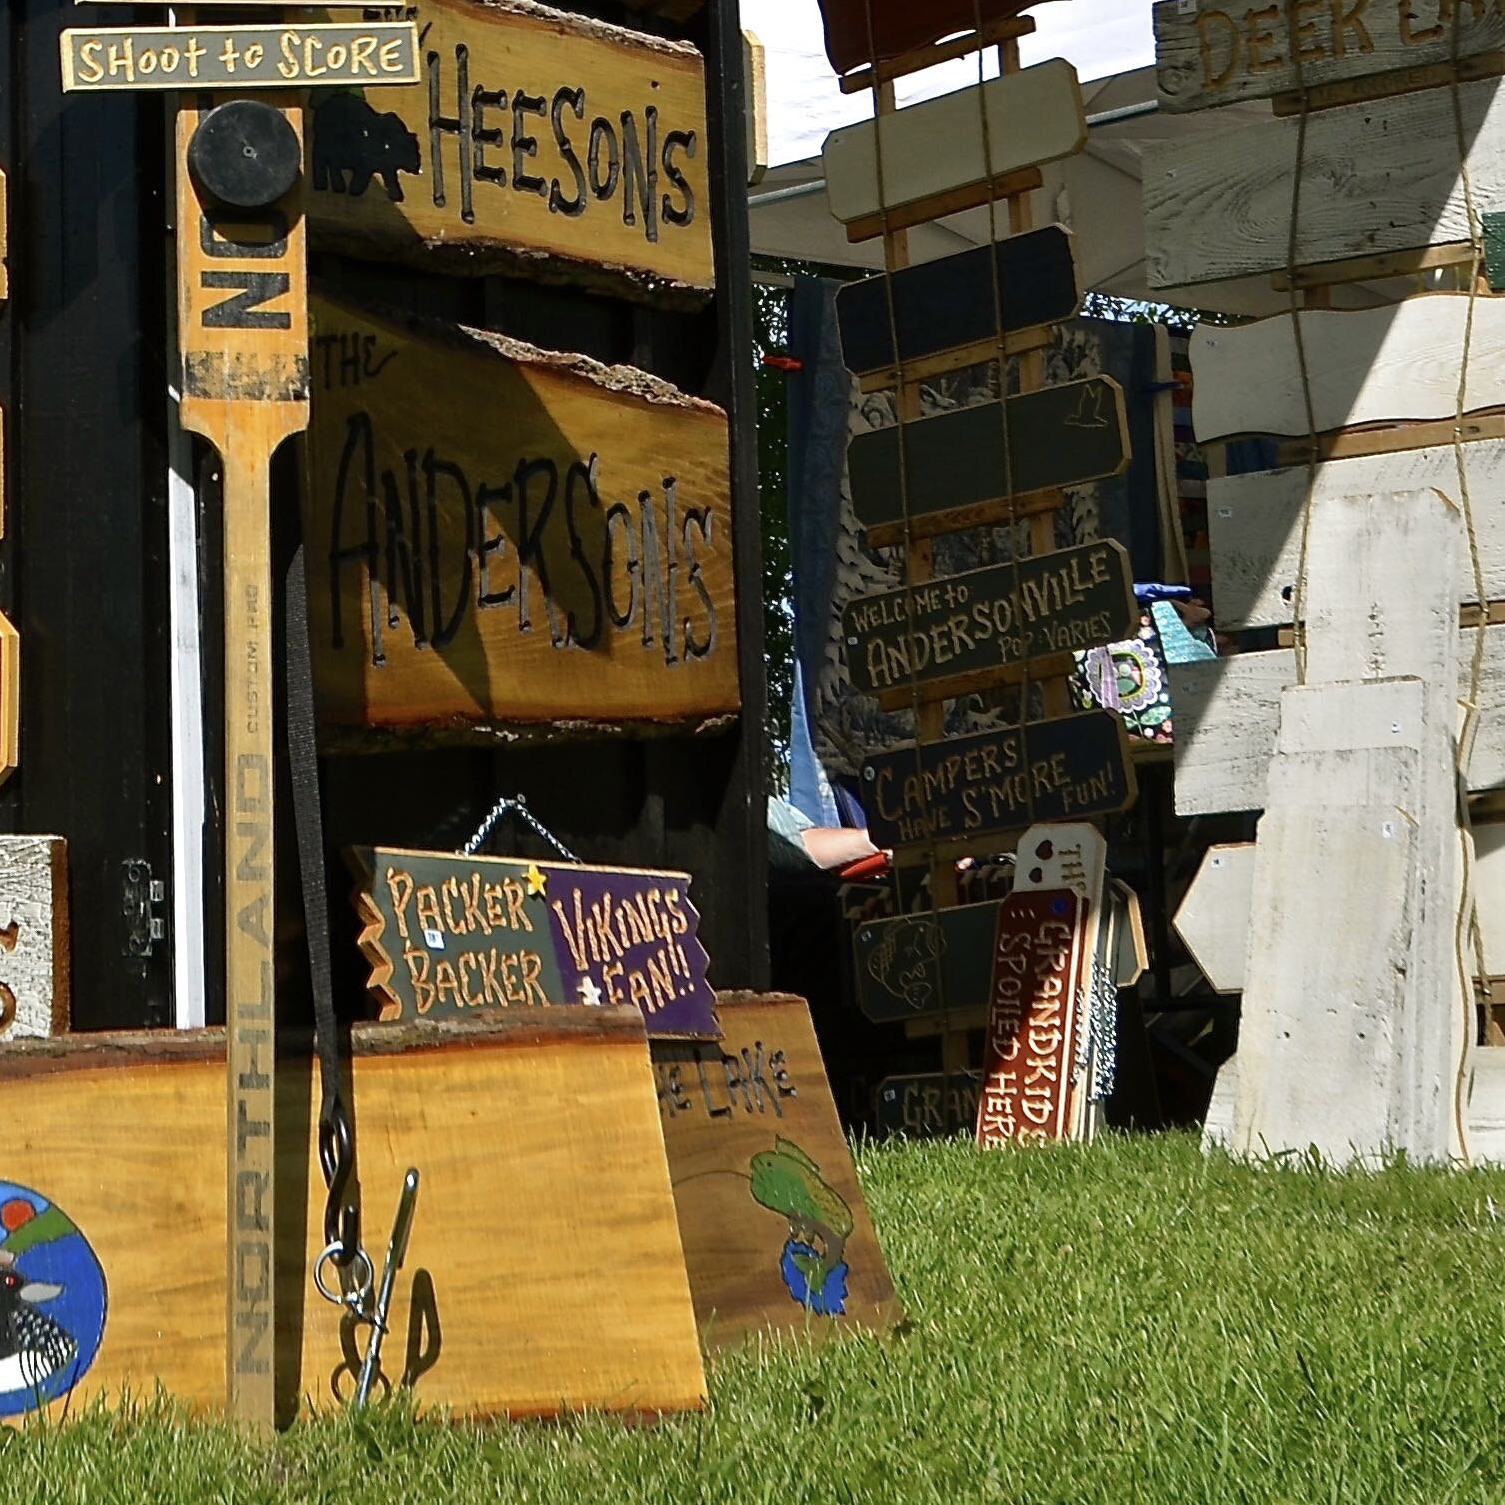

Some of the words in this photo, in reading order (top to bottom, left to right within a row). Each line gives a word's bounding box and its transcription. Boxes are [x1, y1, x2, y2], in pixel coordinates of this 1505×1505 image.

[276, 31, 404, 80] SCORE
[426, 42, 695, 243] HEESONS
[316, 333, 399, 391] THE
[331, 409, 718, 668] ANDERSONS
[876, 737, 1018, 822] CAMPERS
[387, 866, 533, 940] PACKER
[550, 888, 689, 971] VIKINGS
[402, 938, 549, 1014] BACKER
[235, 755, 272, 1375] NORTHLAND
[694, 1041, 798, 1119] LAKE
